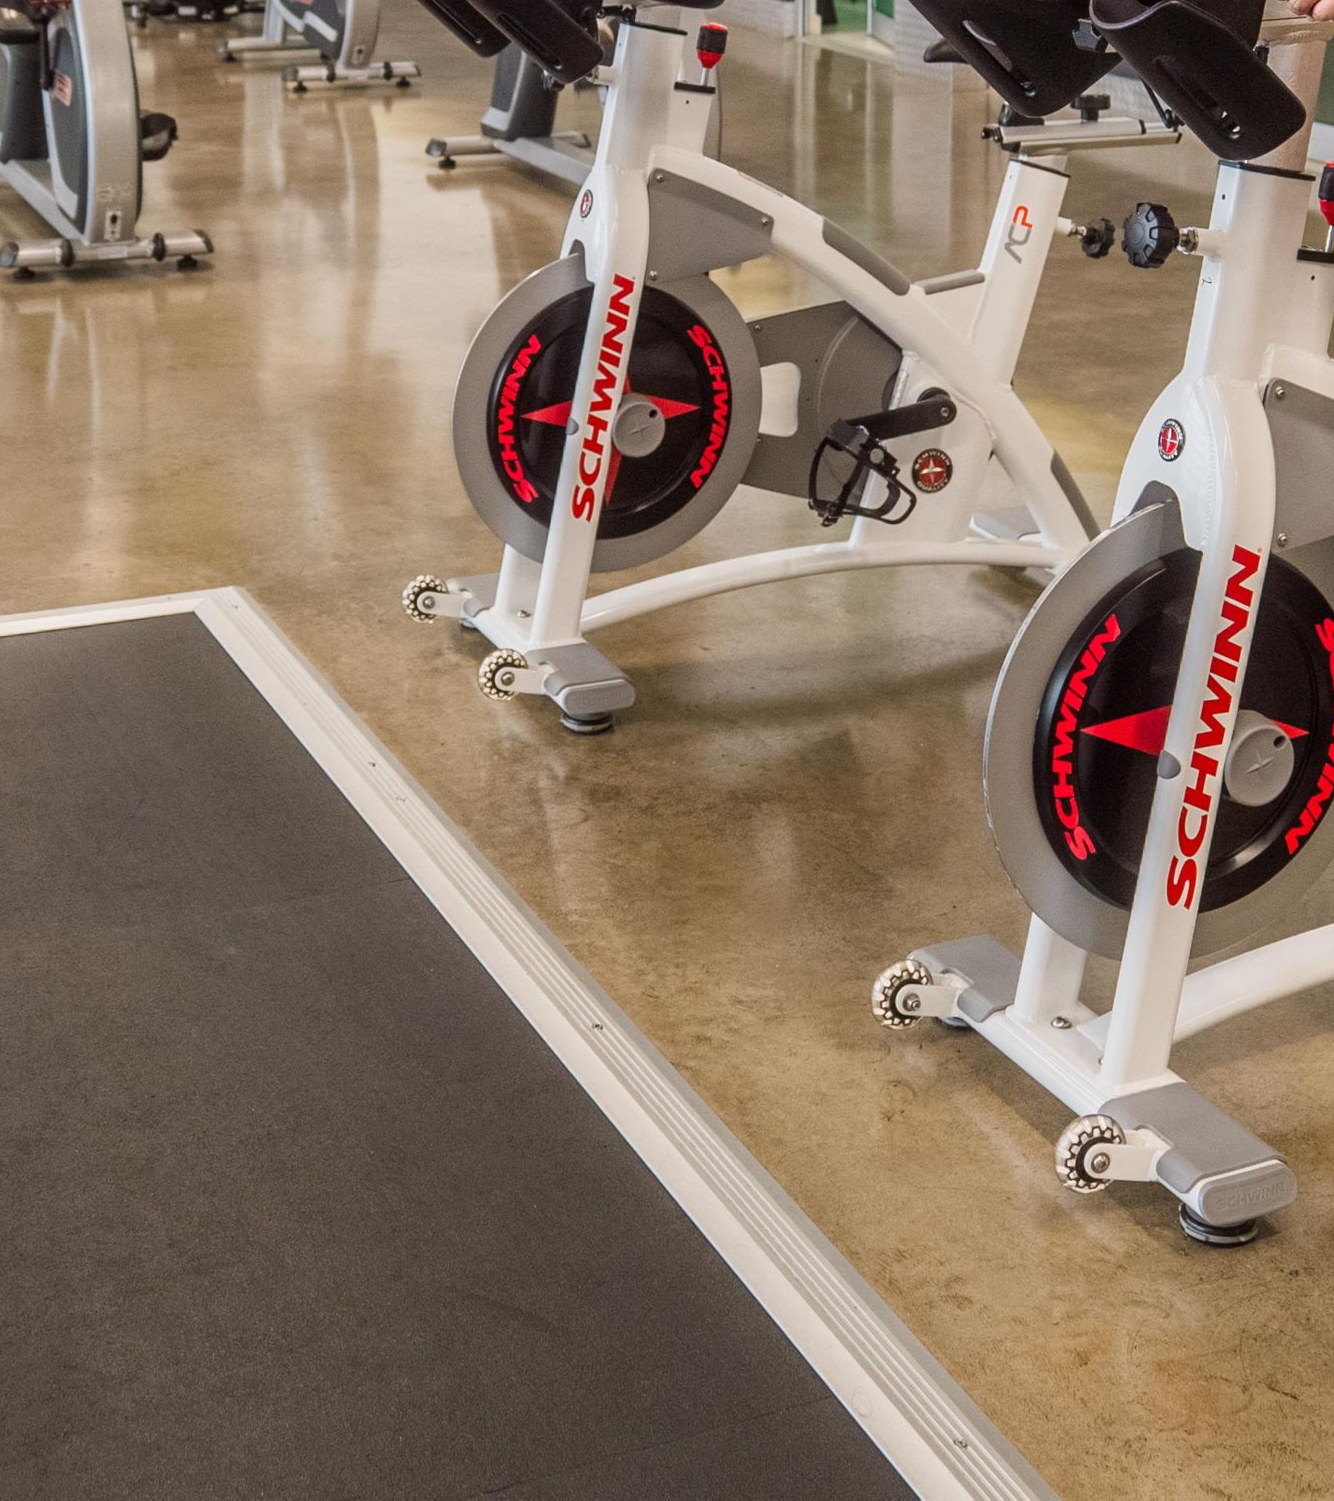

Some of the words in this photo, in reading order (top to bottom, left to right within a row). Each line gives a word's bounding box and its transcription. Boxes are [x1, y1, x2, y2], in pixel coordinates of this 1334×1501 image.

[1004, 205, 1033, 265] ACP
[498, 335, 541, 504] SCHWINN
[572, 274, 634, 522] SCHWINN
[687, 324, 731, 488] SCHWINN
[1052, 613, 1121, 861] SCHWINN
[1166, 545, 1261, 910] SCHWINN
